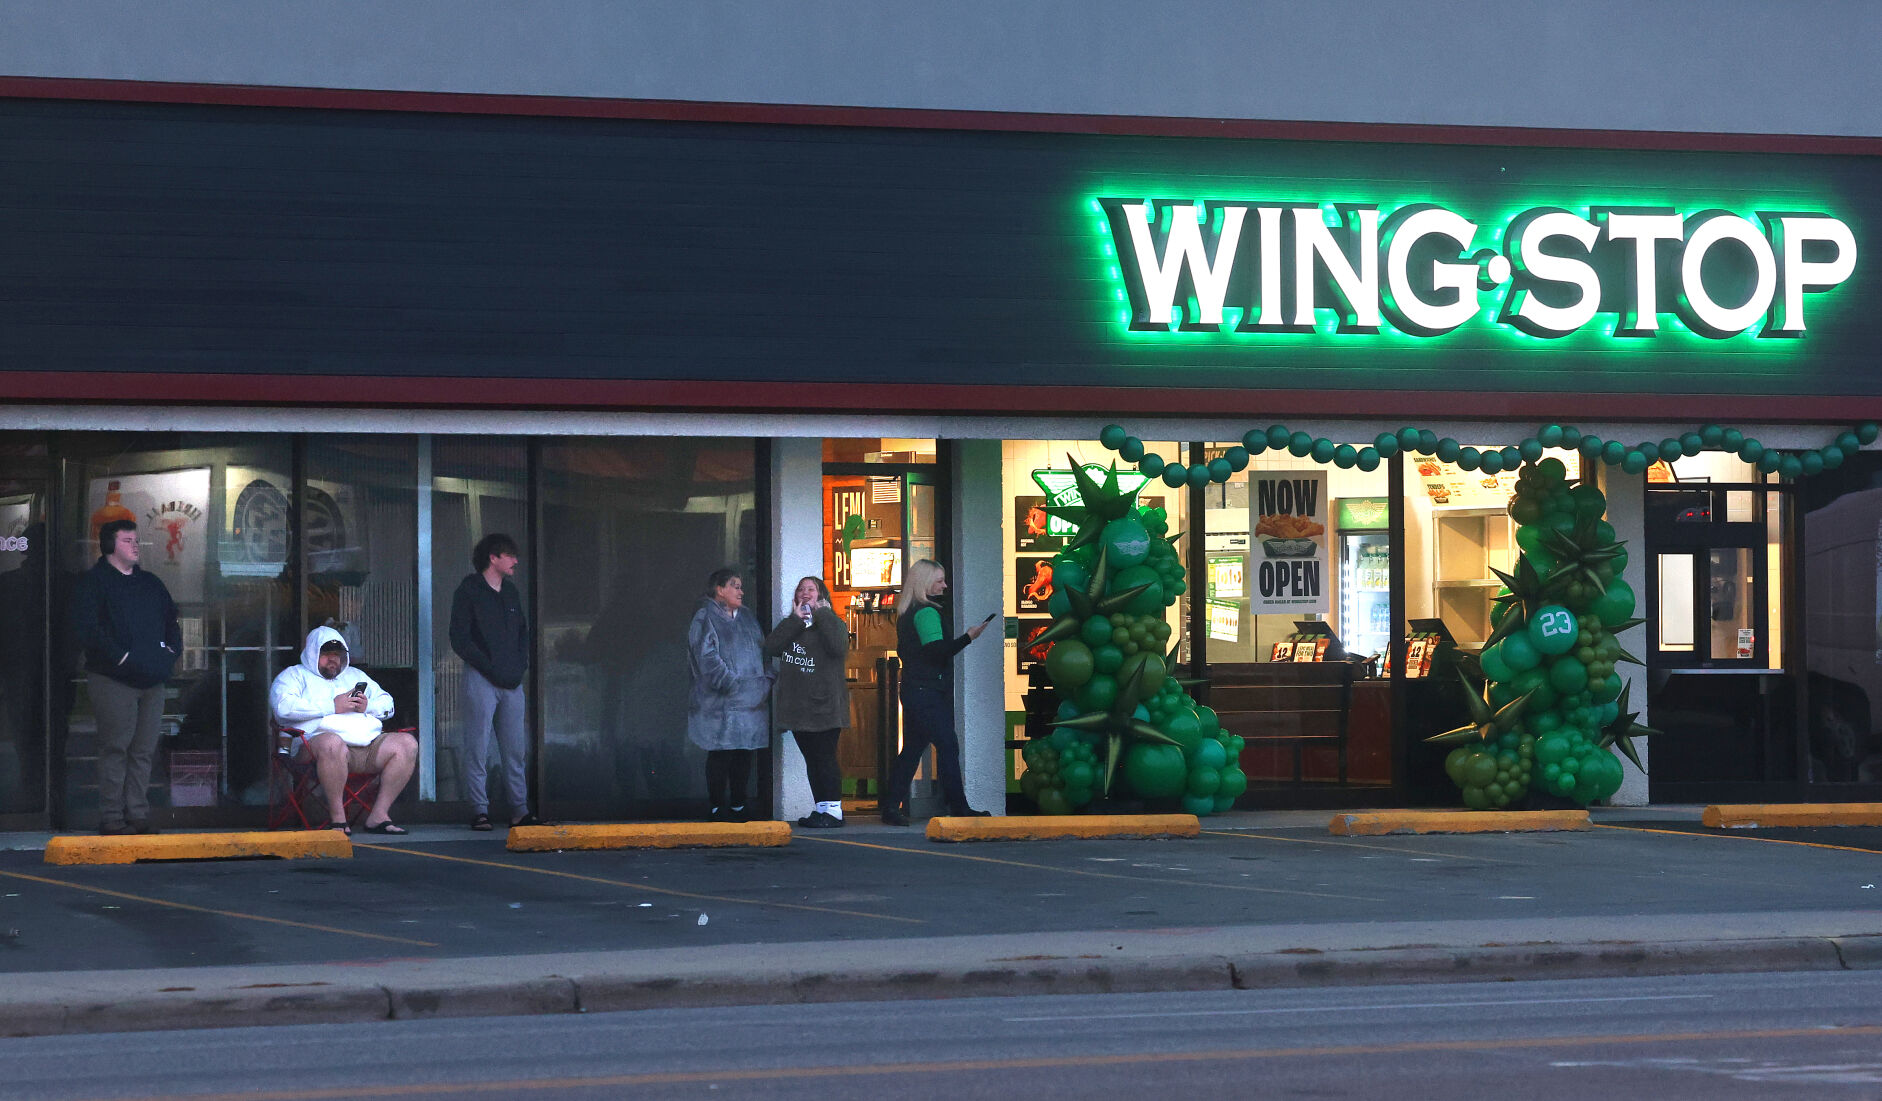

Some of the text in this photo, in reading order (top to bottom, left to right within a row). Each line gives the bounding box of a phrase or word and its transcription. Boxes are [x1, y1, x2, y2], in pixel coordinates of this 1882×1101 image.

[1259, 479, 1318, 516] NOW
[1259, 561, 1320, 597] OPEN
[1540, 611, 1571, 637] 23
[1411, 646, 1421, 657] 12
